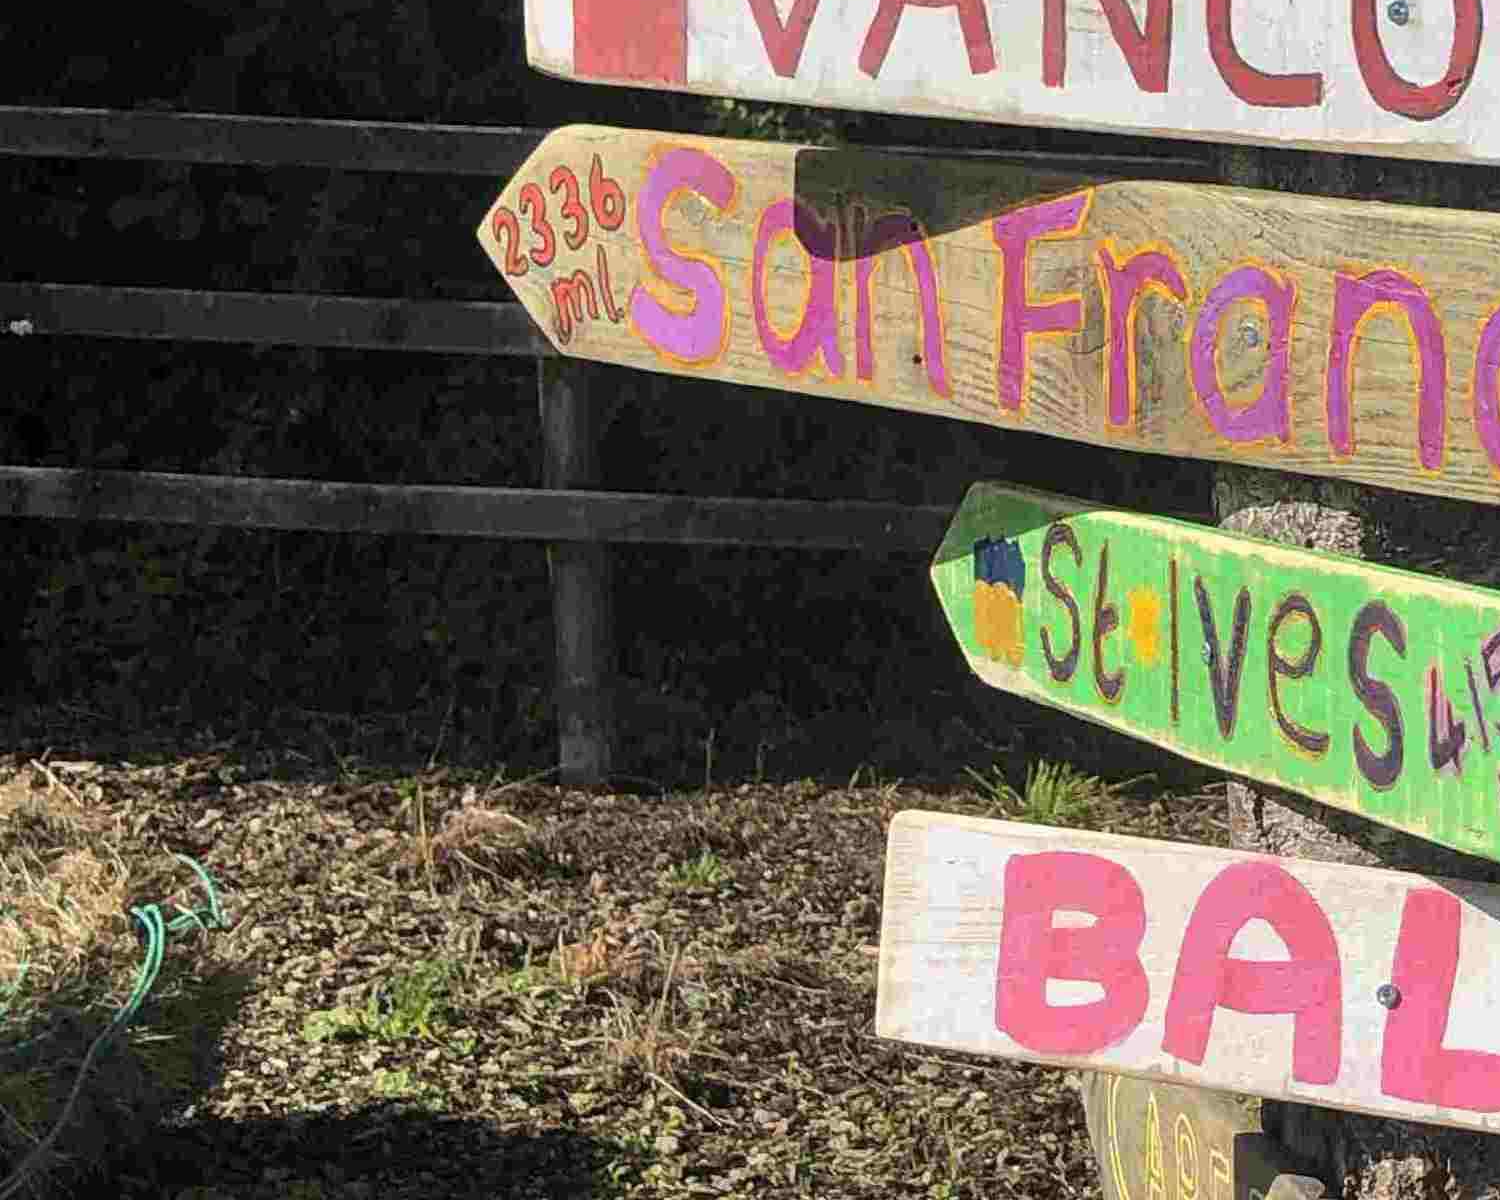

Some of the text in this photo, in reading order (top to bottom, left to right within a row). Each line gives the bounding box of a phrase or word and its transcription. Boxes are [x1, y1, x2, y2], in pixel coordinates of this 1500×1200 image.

[492, 152, 627, 277] 2336
[628, 140, 955, 402] San
[1037, 521, 1127, 706] St
